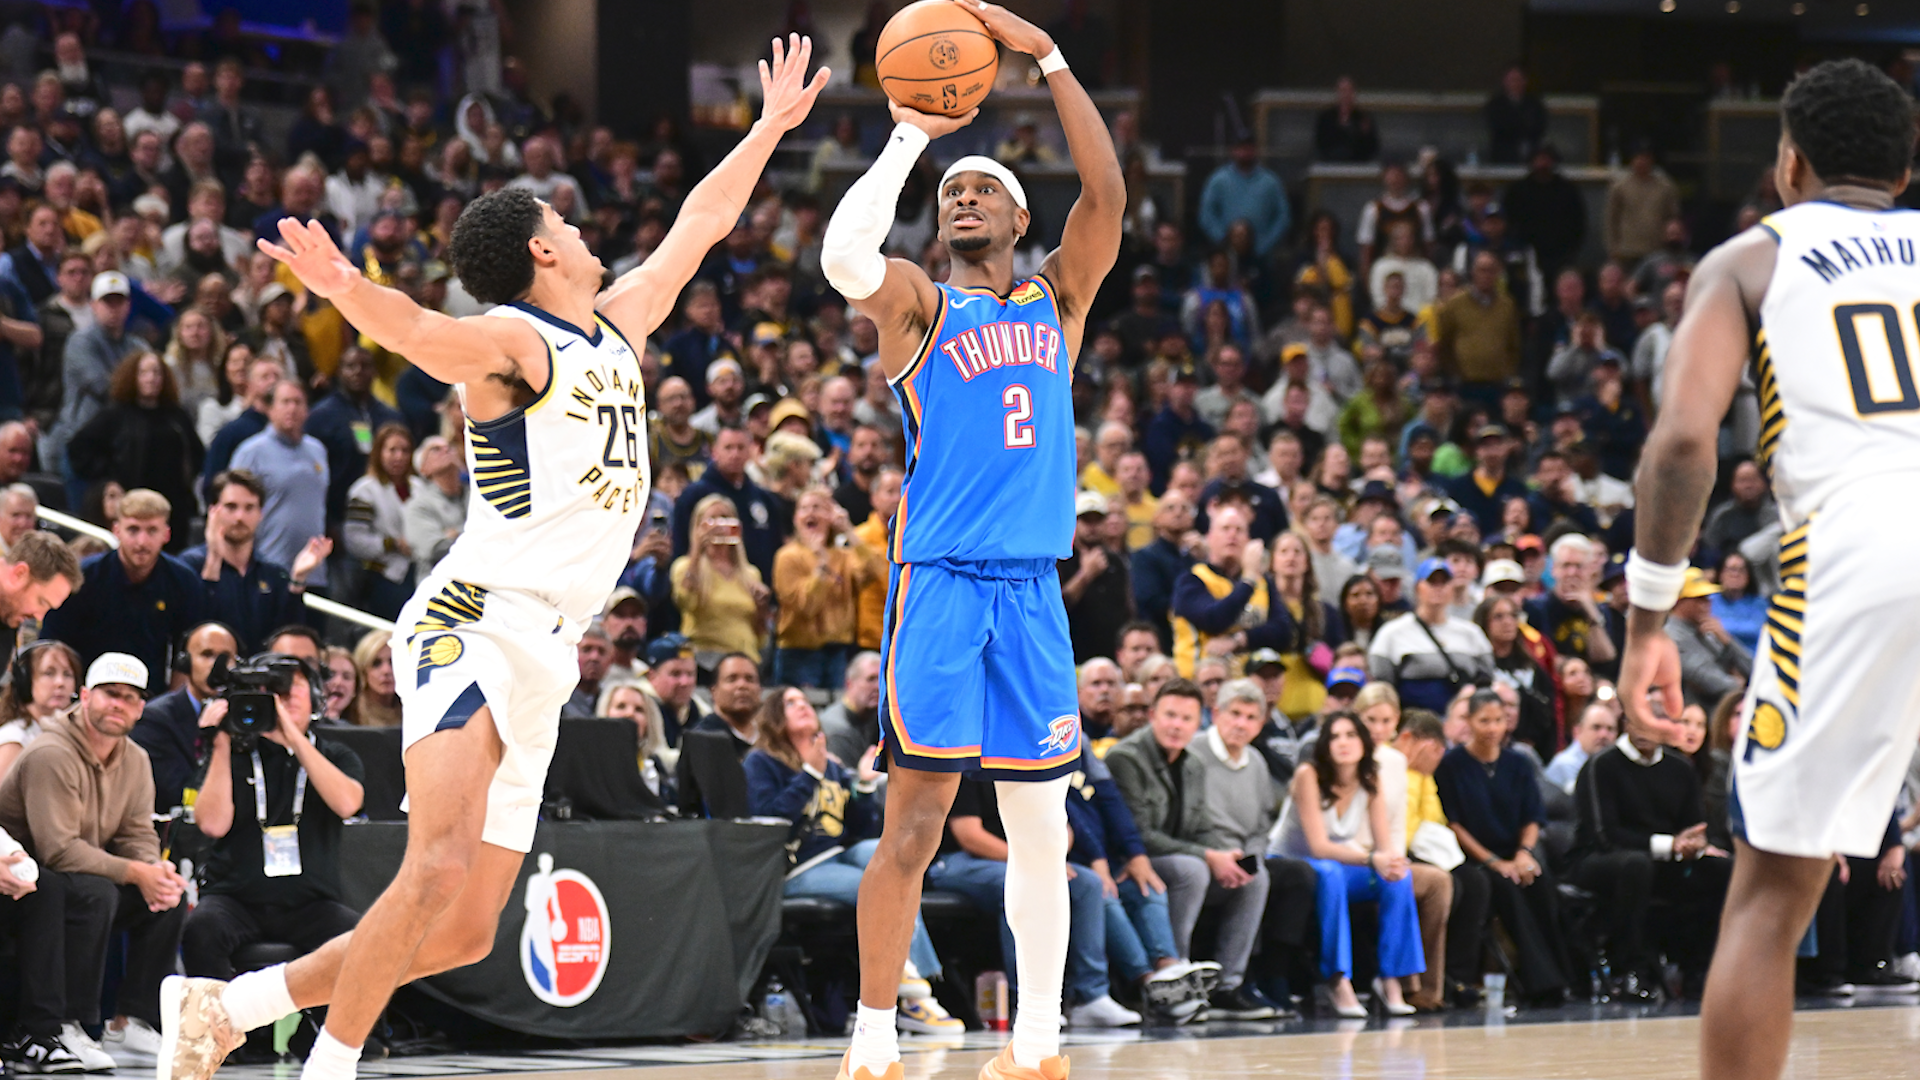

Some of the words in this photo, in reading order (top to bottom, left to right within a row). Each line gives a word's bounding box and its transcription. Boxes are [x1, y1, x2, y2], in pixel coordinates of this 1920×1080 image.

[940, 321, 1060, 383] THUNDER
[597, 403, 638, 468] 26
[1002, 384, 1036, 449] 2
[556, 944, 600, 963] ESPN
[577, 917, 600, 942] NBA
